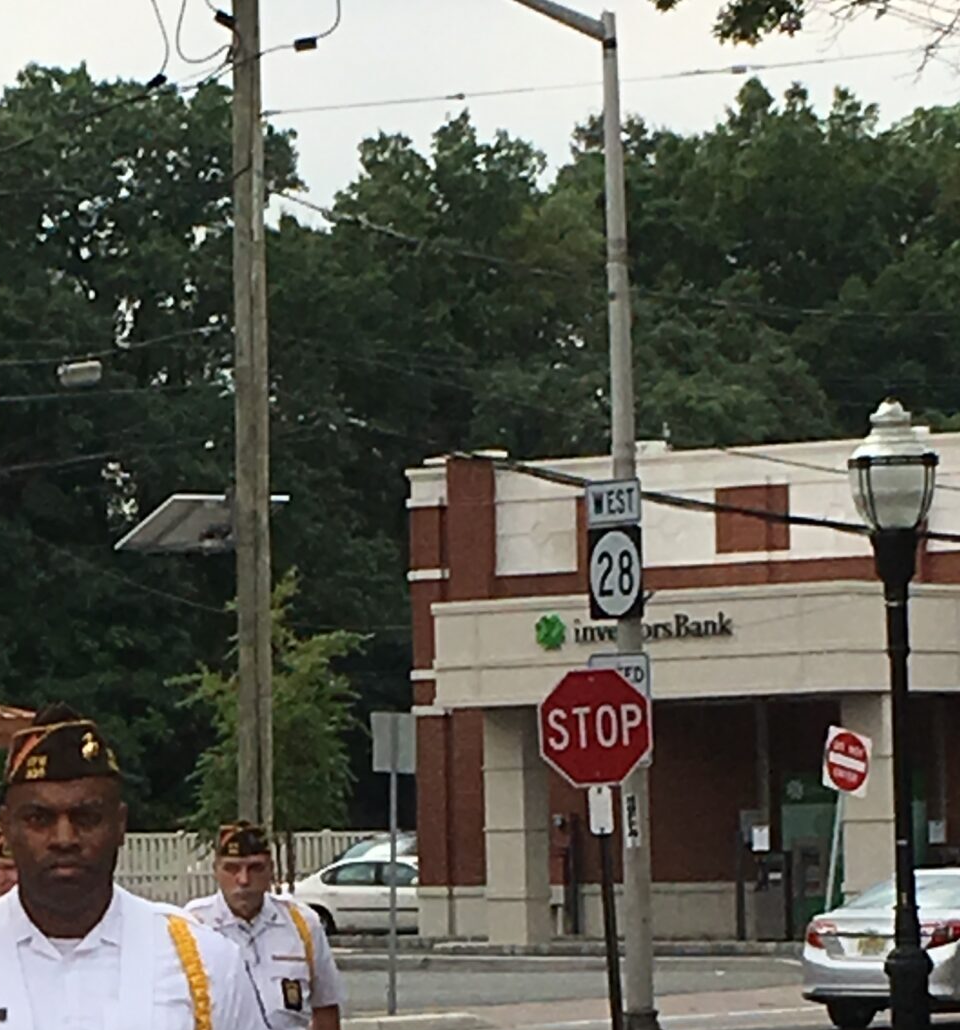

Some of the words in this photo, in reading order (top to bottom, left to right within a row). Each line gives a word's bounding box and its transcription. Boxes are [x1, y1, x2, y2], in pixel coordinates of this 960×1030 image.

[592, 487, 634, 514] WEST
[597, 549, 633, 597] 28
[574, 611, 733, 644] inveorsBank
[548, 704, 642, 750] STOP
